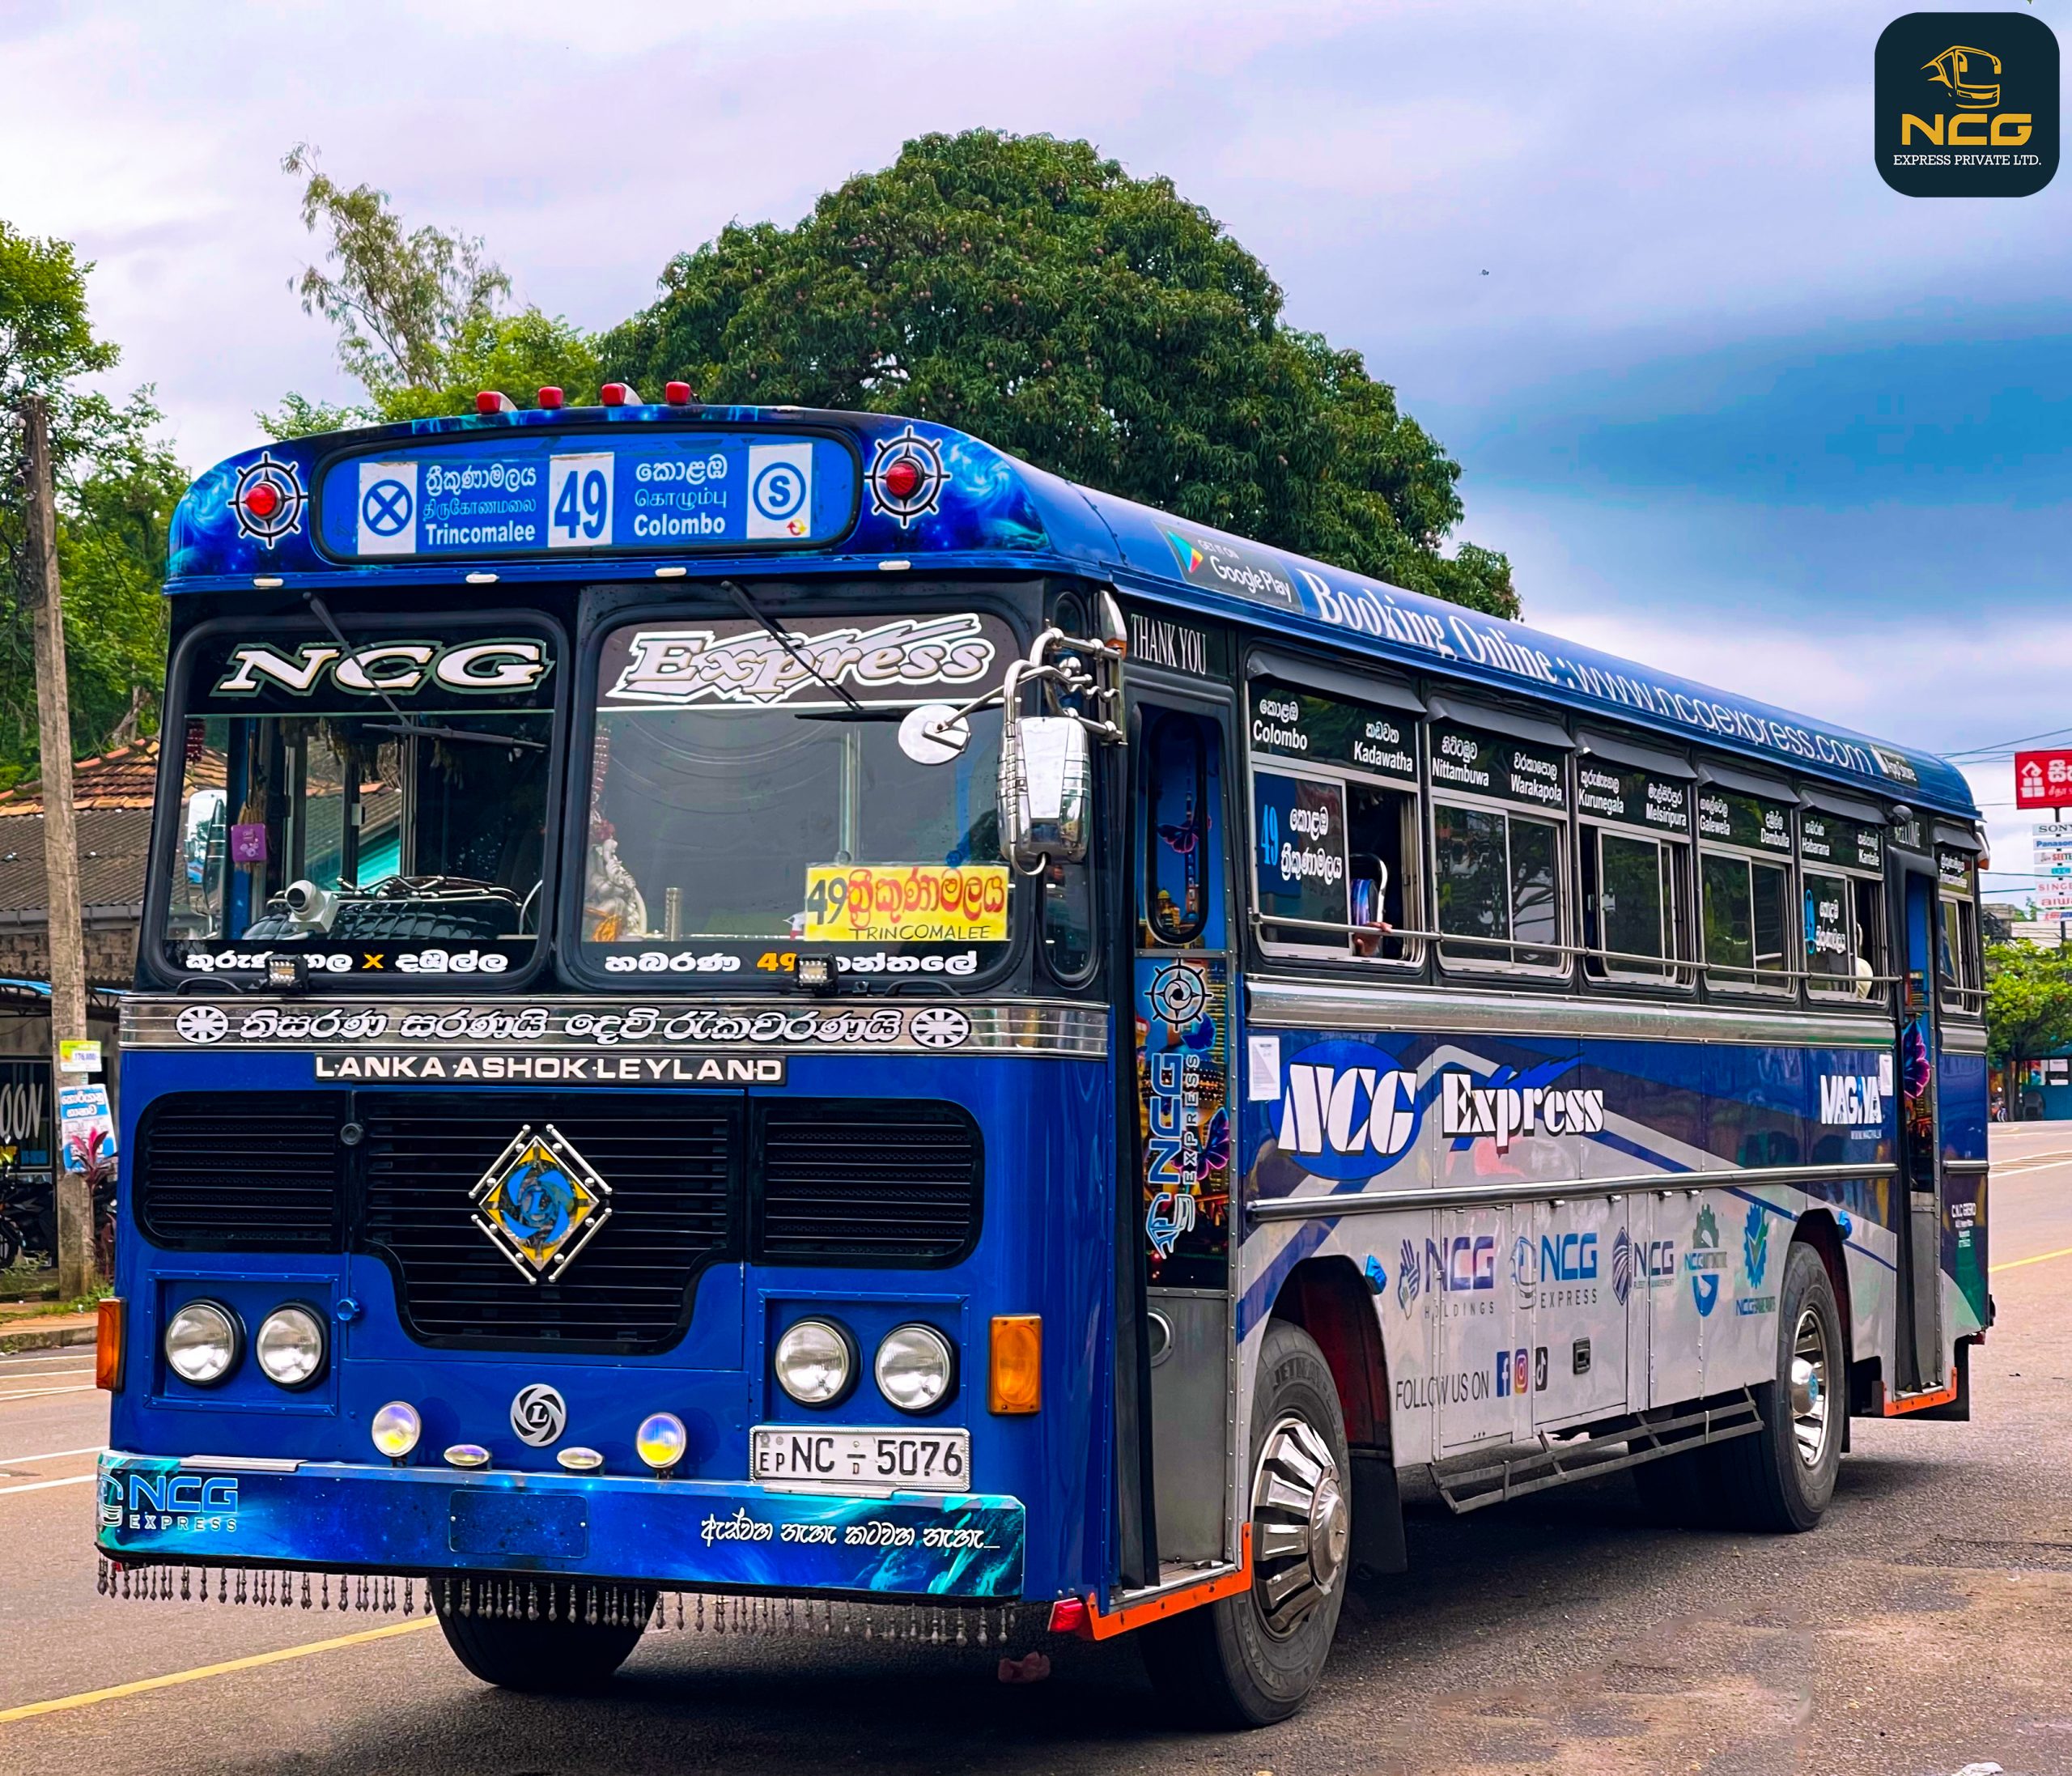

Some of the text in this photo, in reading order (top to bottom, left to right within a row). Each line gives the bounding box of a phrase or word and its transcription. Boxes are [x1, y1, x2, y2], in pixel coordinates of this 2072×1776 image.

[635, 453, 728, 485] කොළඹ
[422, 497, 537, 522] திருகோணமலை
[554, 469, 608, 540] 49
[635, 486, 727, 511] கொழும்பு
[425, 520, 536, 546] Trincomalee
[634, 512, 726, 537] Colombo
[1210, 555, 1292, 602] Google Play
[1296, 568, 1457, 661] Booking
[606, 613, 996, 703] Express
[1131, 613, 1206, 674] THANK YOU
[210, 638, 556, 697] NCG
[1253, 720, 1308, 750] Colombo
[1353, 741, 1413, 772] Kadawatha
[1432, 757, 1489, 787] Nittambuwa
[1510, 774, 1562, 802] Warakapola
[1578, 788, 1624, 816] Kurunegala
[1261, 805, 1279, 866] 49
[1289, 806, 1328, 840] කොළඹ
[807, 877, 847, 925] 49
[2041, 898, 2072, 906] aiw
[848, 924, 991, 941] TRINCOMALEE
[395, 950, 508, 973] දඹුල්ල
[605, 952, 741, 973] හබරණ
[757, 952, 797, 971] 49
[316, 1056, 782, 1081] LANKA ASHOK LEYLAND
[1149, 1052, 1183, 1184] NCG
[1182, 1053, 1201, 1184] EXPRESS
[1278, 1063, 1604, 1155] NCG Express
[1425, 1235, 1494, 1293] NCG
[1541, 1233, 1598, 1282] NCG
[1633, 1241, 1674, 1277] NCG
[1424, 1302, 1495, 1319] HOLDINGS
[1540, 1289, 1598, 1309] EXPRESS
[1395, 1370, 1489, 1411] FOLLOW US ON
[792, 1436, 834, 1473] NC
[877, 1439, 963, 1477] 5076
[130, 1474, 238, 1513] NCG
[130, 1514, 237, 1532] EXPRESS
